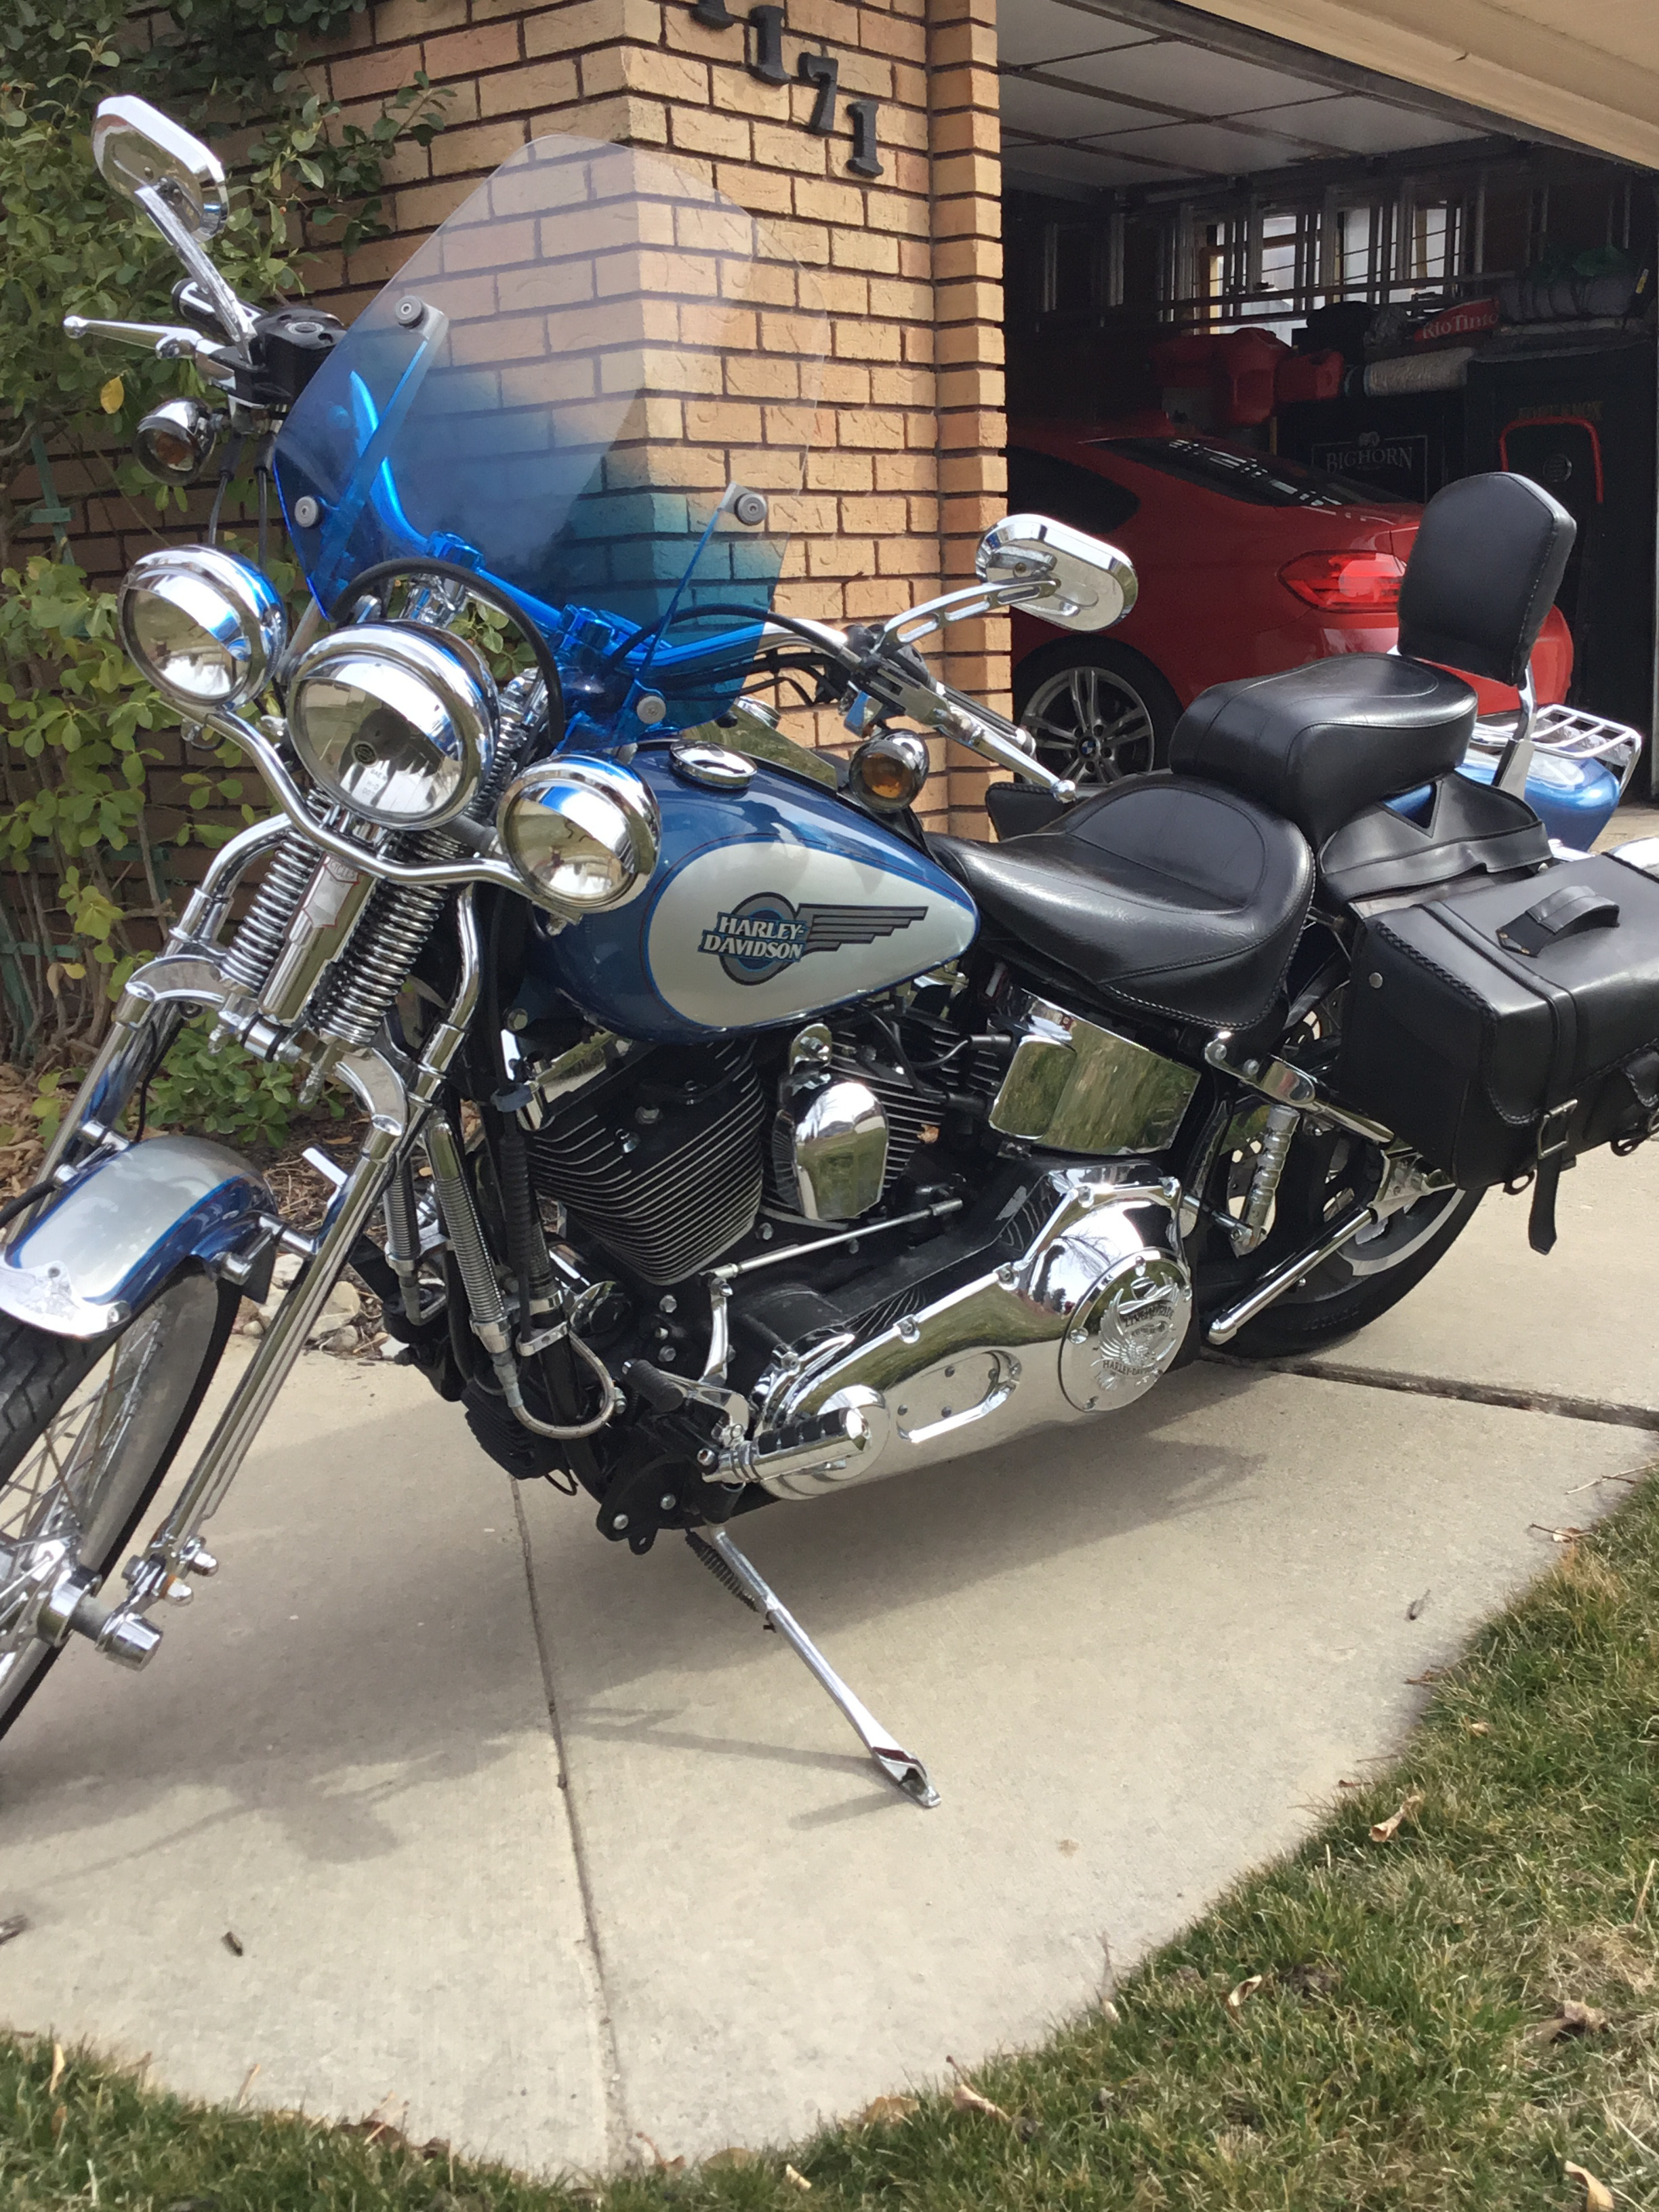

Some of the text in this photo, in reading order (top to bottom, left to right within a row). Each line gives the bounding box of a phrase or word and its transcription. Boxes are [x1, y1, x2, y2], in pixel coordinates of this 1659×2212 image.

[1326, 447, 1412, 473] BIGHORN
[718, 916, 804, 940] HARLEY-
[703, 935, 803, 960] DAVIDSON
